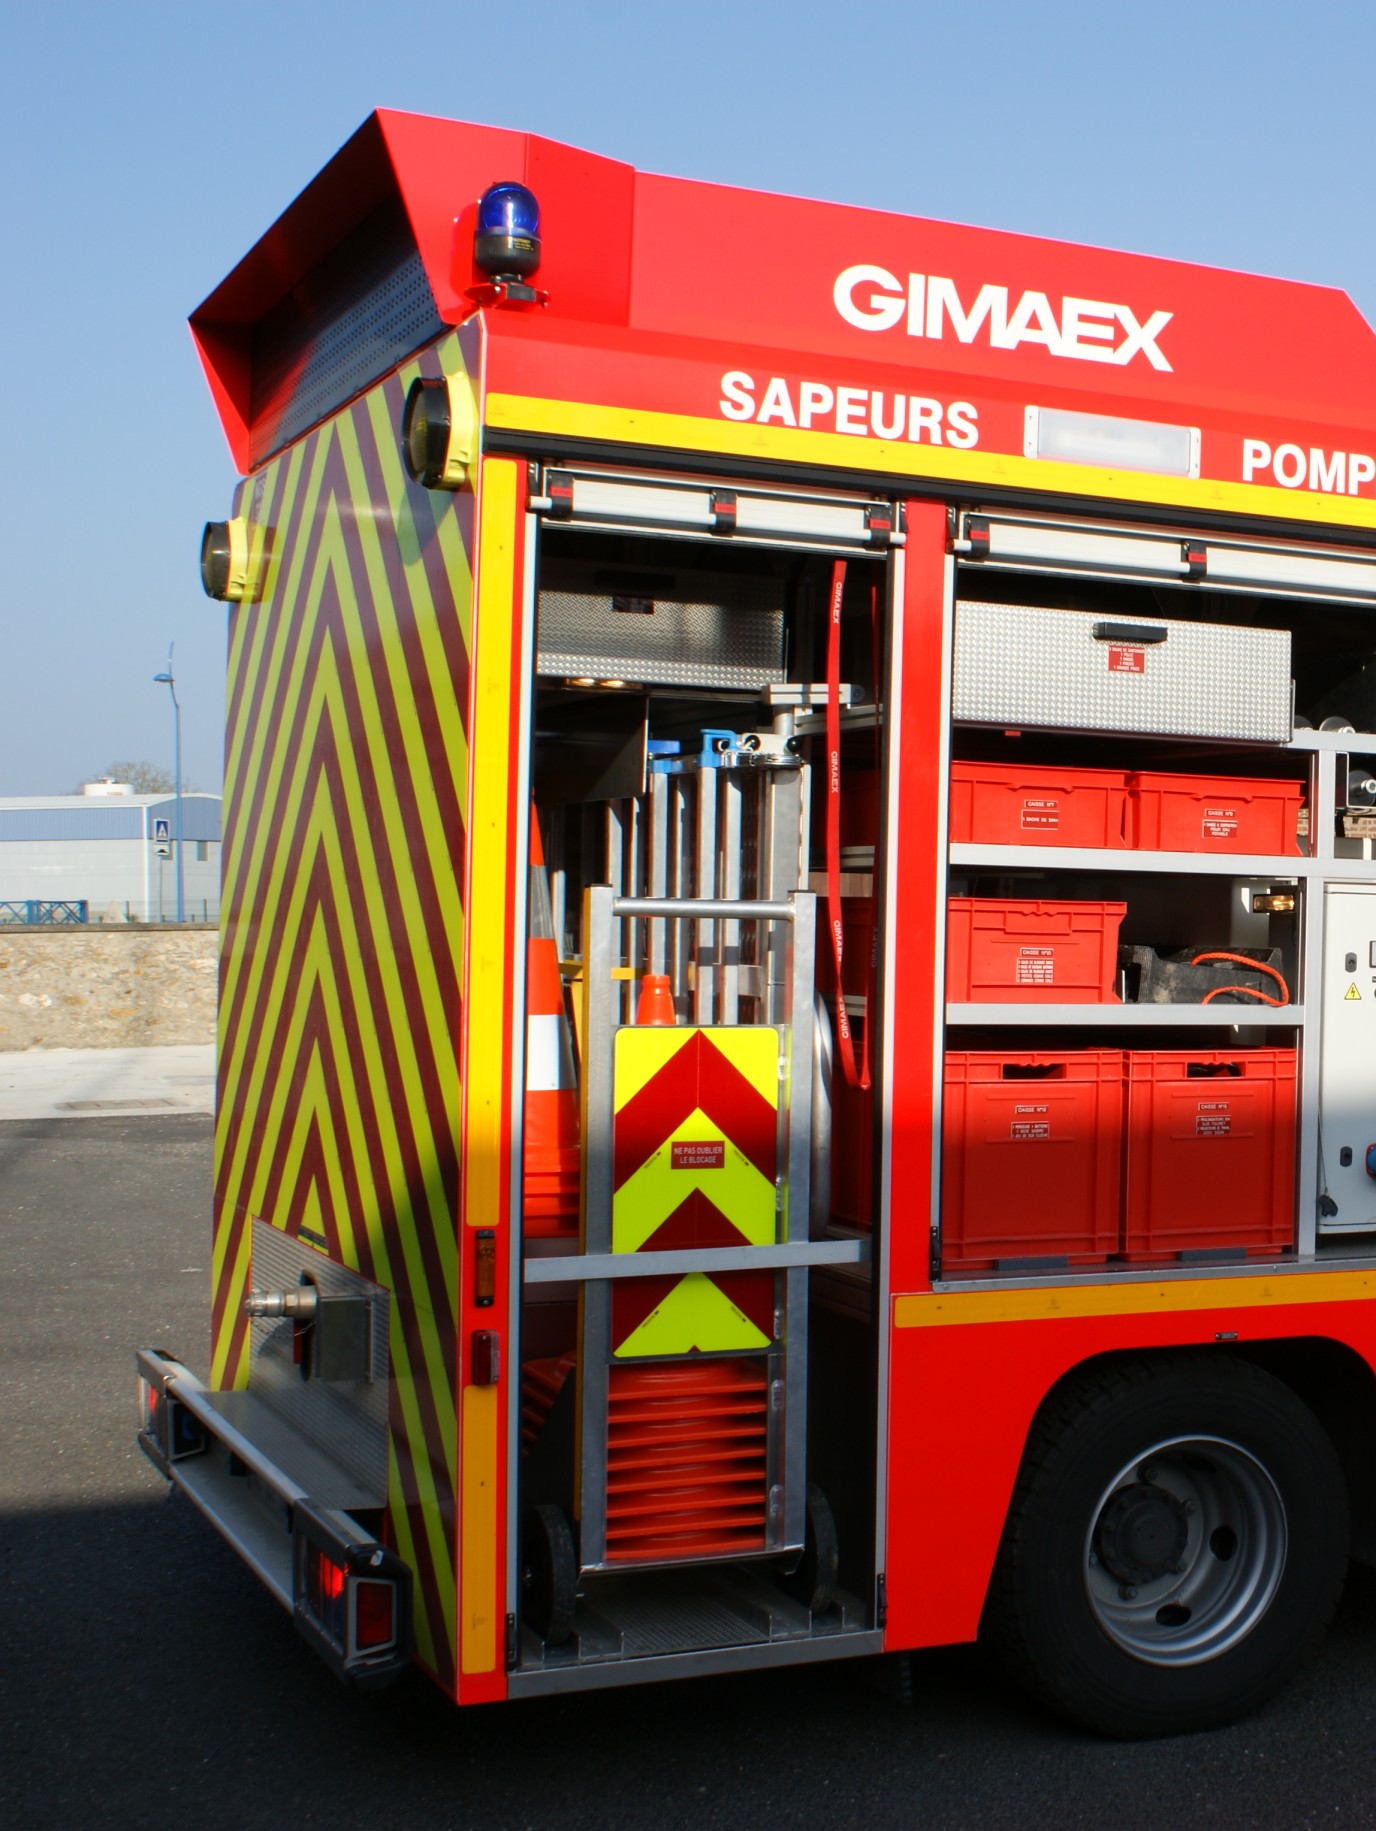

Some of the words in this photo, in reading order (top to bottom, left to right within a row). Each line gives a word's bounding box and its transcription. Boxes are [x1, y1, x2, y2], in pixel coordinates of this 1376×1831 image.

[833, 264, 1174, 373] GIMAEX
[719, 370, 979, 449] SAPEURS
[833, 582, 842, 624] GIMAEX
[831, 751, 840, 793] GIMAEX
[834, 920, 843, 962] GIMAEX
[838, 997, 849, 1039] GIMAEX
